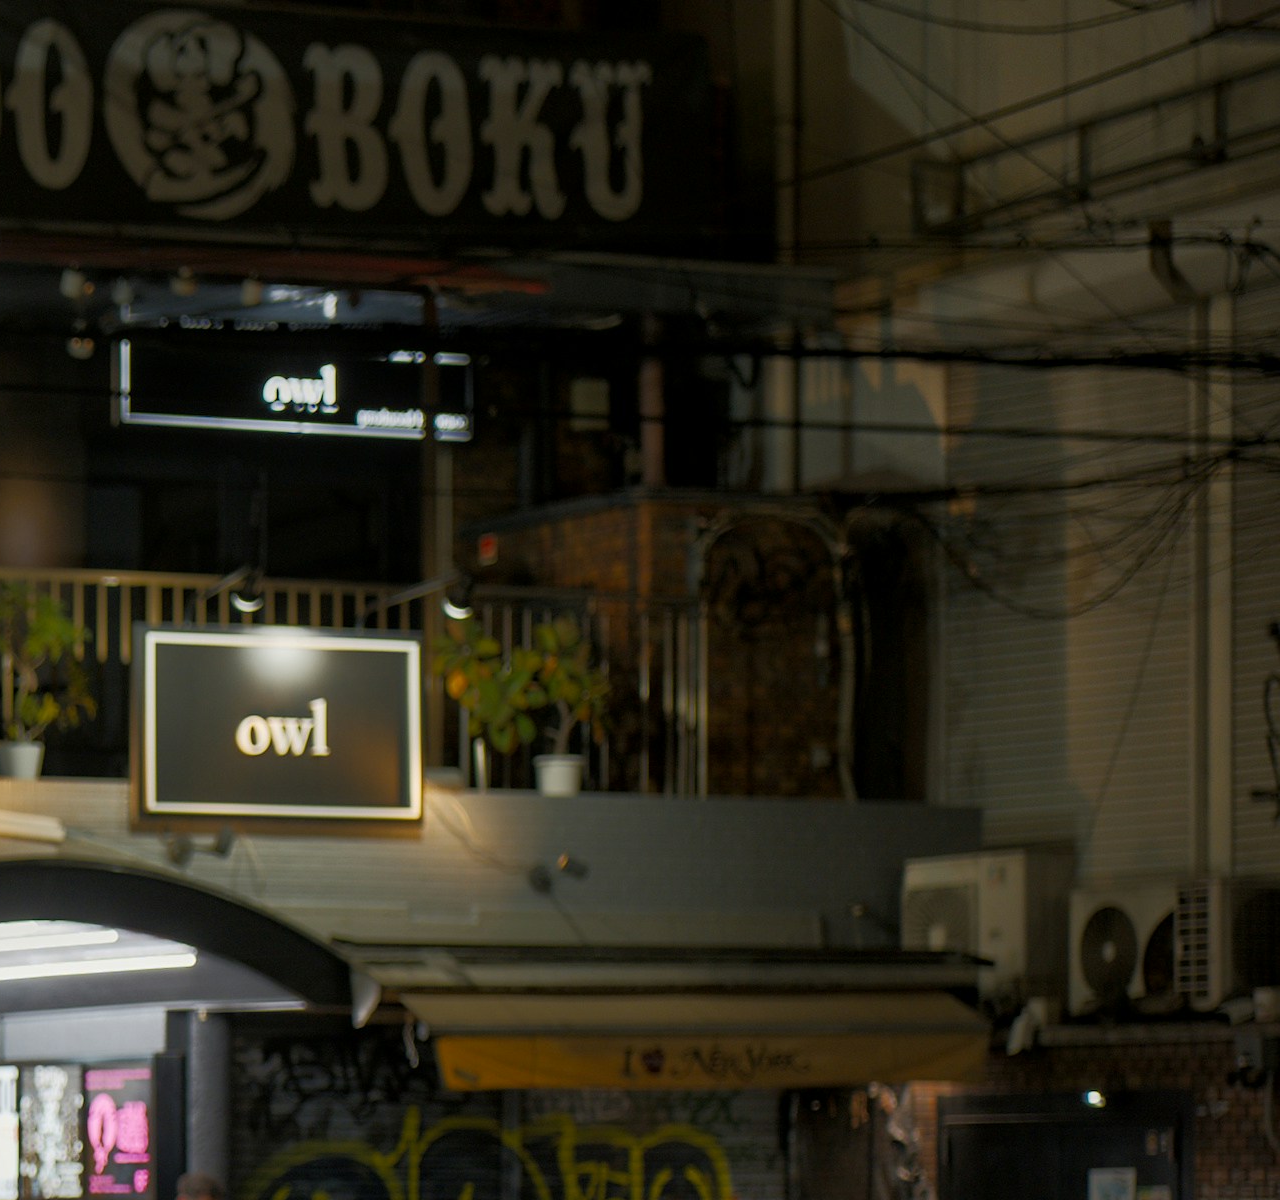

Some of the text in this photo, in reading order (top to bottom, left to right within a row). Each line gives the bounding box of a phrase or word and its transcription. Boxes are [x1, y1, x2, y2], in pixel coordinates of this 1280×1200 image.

[302, 41, 652, 222] BOKU
[263, 363, 339, 413] owl
[236, 697, 331, 757] owl
